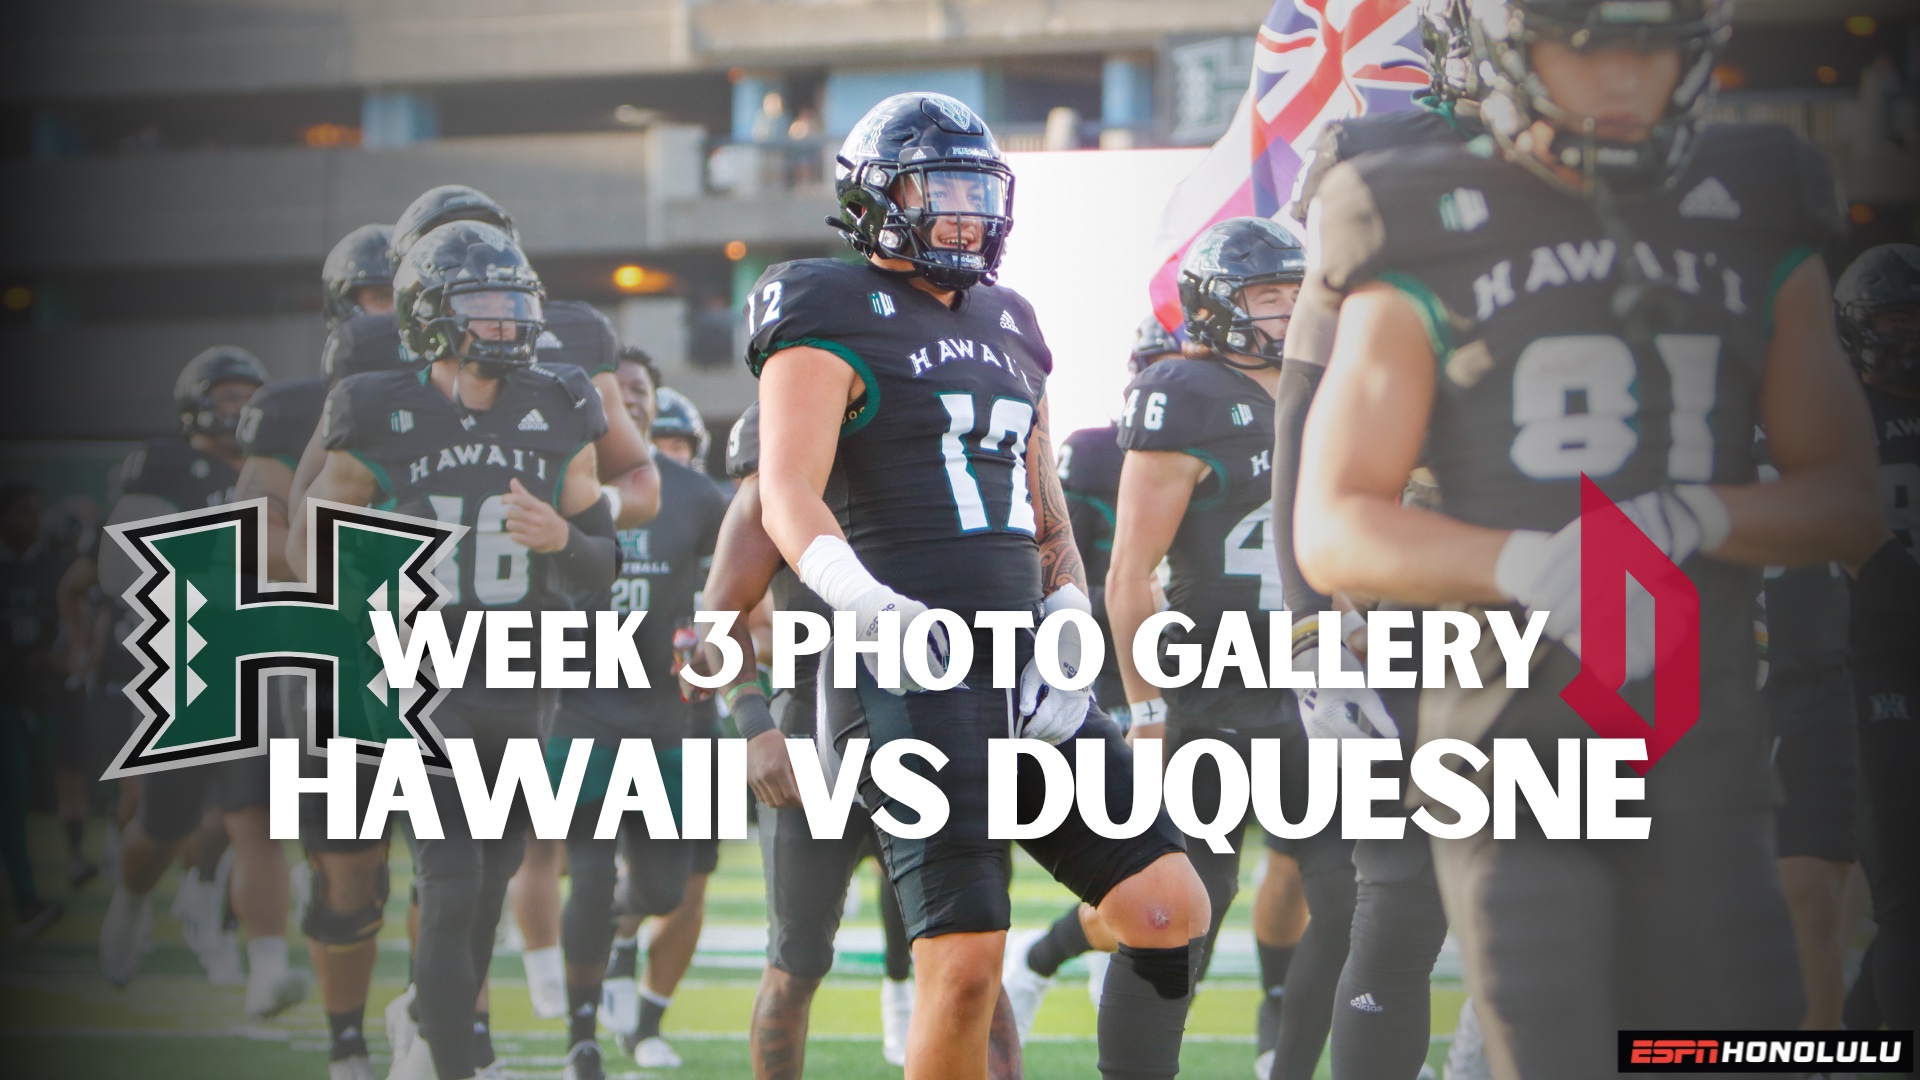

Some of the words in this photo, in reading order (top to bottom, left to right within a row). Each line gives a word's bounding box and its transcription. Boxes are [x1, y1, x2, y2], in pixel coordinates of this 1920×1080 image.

[747, 280, 783, 335] 12
[1120, 389, 1167, 431] 46
[1510, 334, 1720, 483] 81
[409, 443, 546, 484] HAWAI'I
[939, 392, 1036, 534] 12
[428, 494, 530, 606] 16
[1225, 498, 1284, 610] 4
[611, 578, 650, 613] 20
[1350, 999, 1383, 1012] adidas
